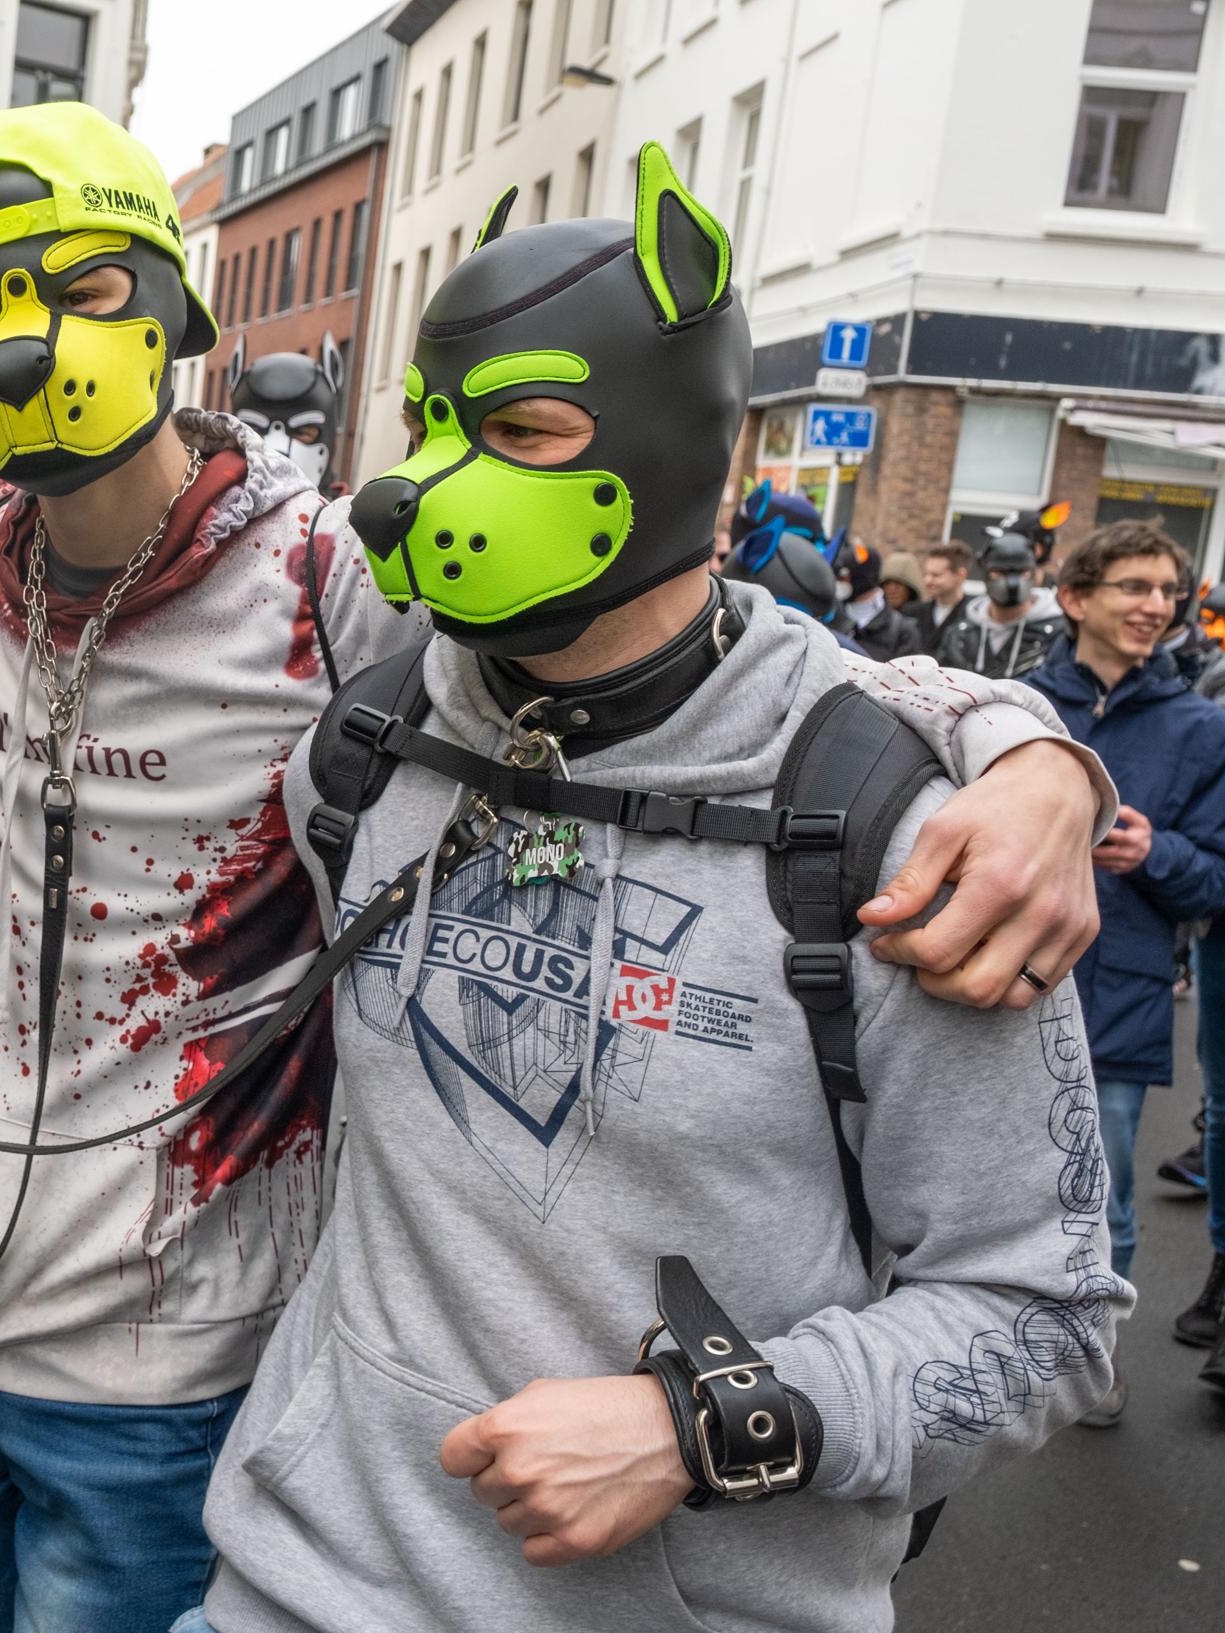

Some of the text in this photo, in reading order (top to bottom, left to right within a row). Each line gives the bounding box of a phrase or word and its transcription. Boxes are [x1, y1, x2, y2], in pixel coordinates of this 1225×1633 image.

[85, 206, 133, 218] FACTORY
[102, 187, 161, 222] YAMAHA
[524, 842, 565, 867] MONO
[678, 1000, 753, 1024] SKATEBOARD
[679, 990, 734, 1010] ATHLETIC
[675, 1019, 754, 1044] AND APPAREL.
[677, 1009, 738, 1030] FOOTWEAR
